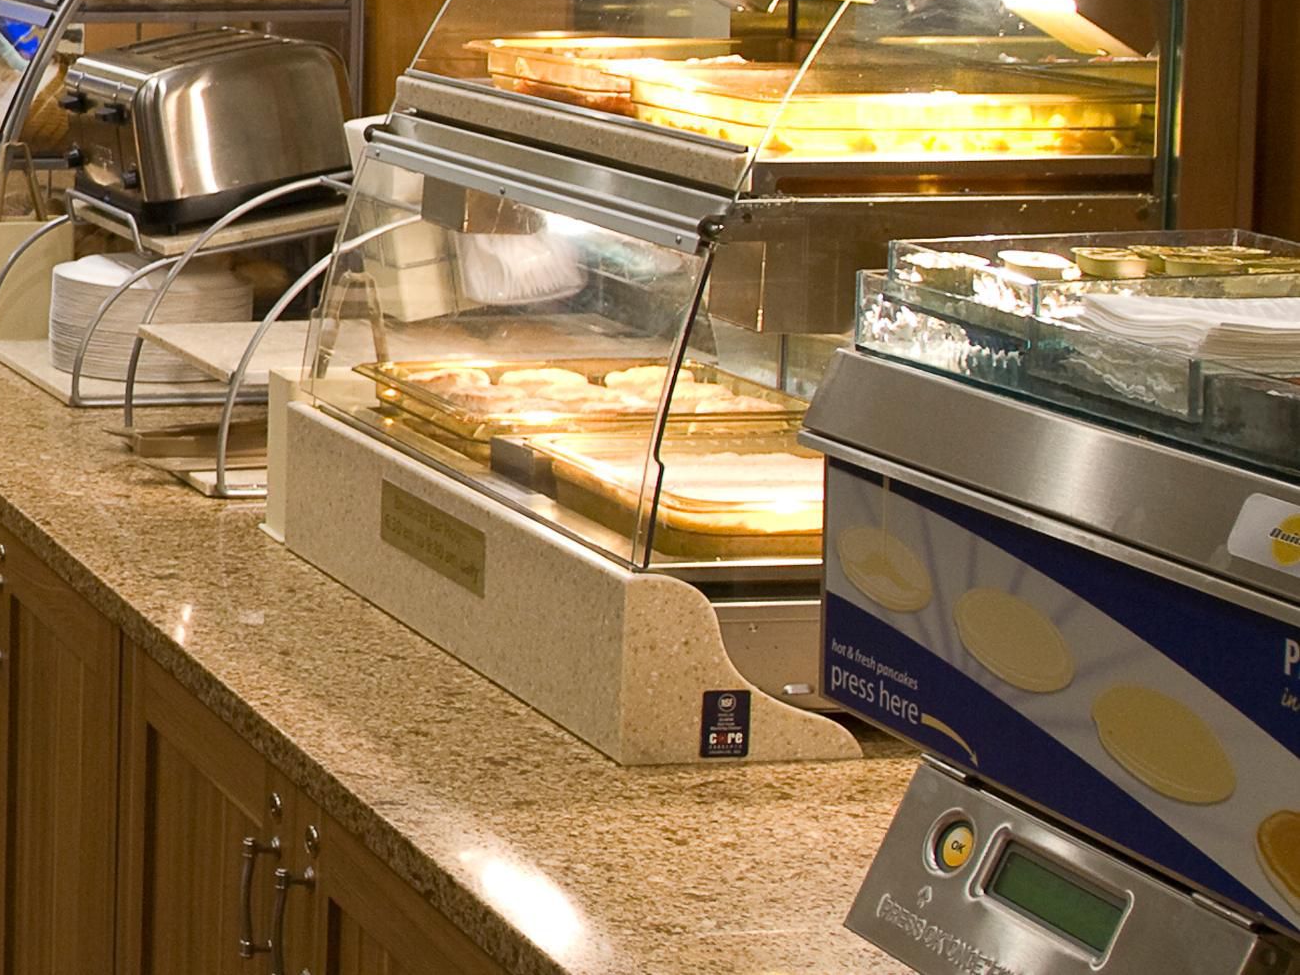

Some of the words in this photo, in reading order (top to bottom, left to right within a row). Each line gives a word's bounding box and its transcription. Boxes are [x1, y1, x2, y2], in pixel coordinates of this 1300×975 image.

[832, 637, 846, 657] hot
[855, 649, 877, 671] fresh
[876, 662, 919, 691] pancakes
[831, 664, 875, 703] press
[879, 680, 919, 725] here
[951, 840, 965, 855] OK
